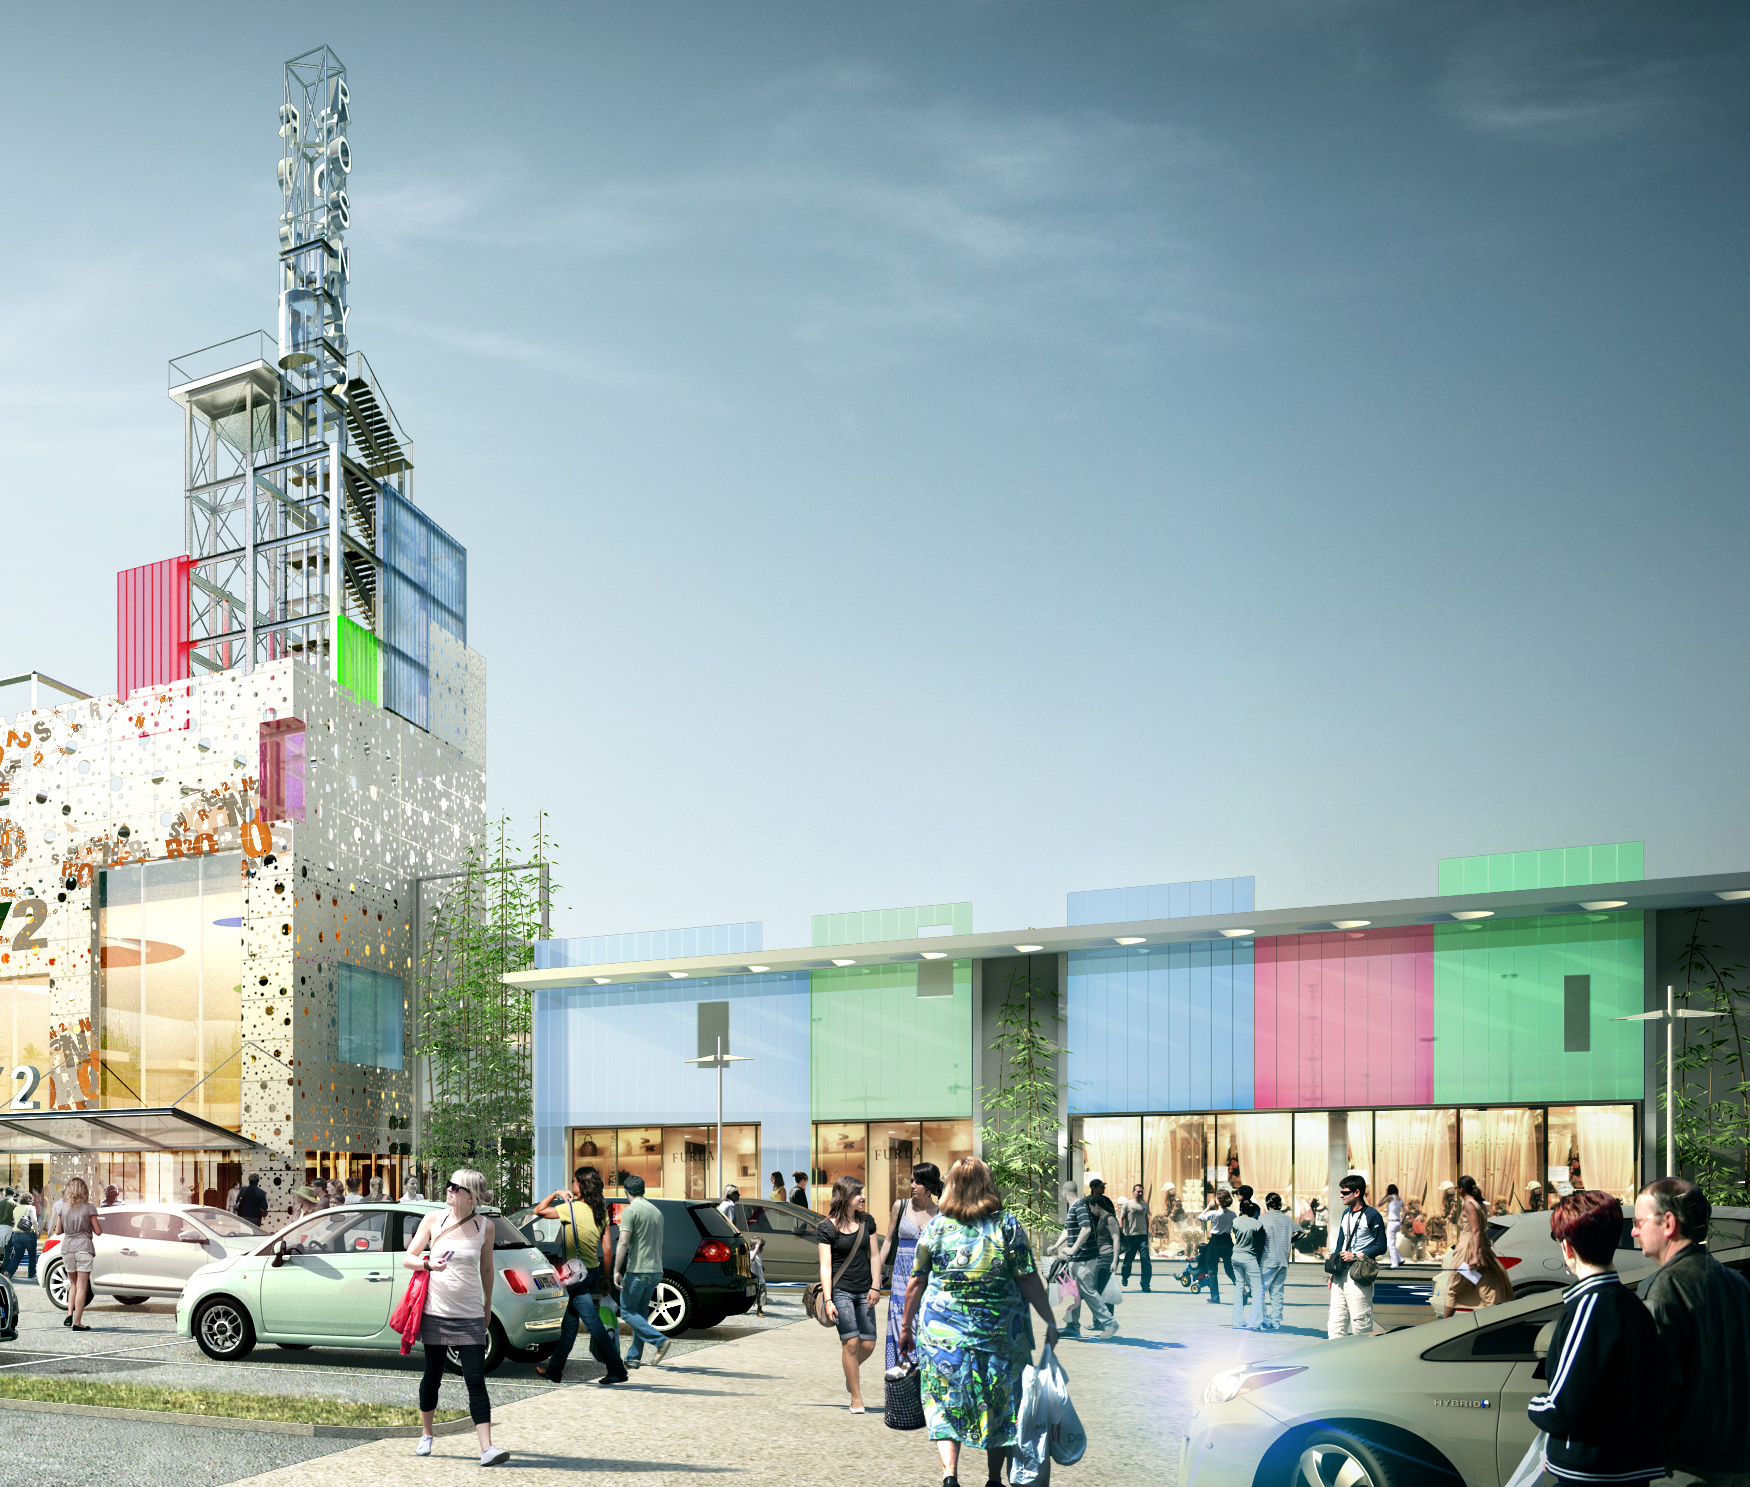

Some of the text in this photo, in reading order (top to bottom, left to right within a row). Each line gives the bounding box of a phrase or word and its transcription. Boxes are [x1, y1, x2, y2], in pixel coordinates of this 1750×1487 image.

[672, 1150, 715, 1163] FURLA
[874, 1147, 922, 1161] FURLA
[1433, 1399, 1482, 1408] HYBRID
